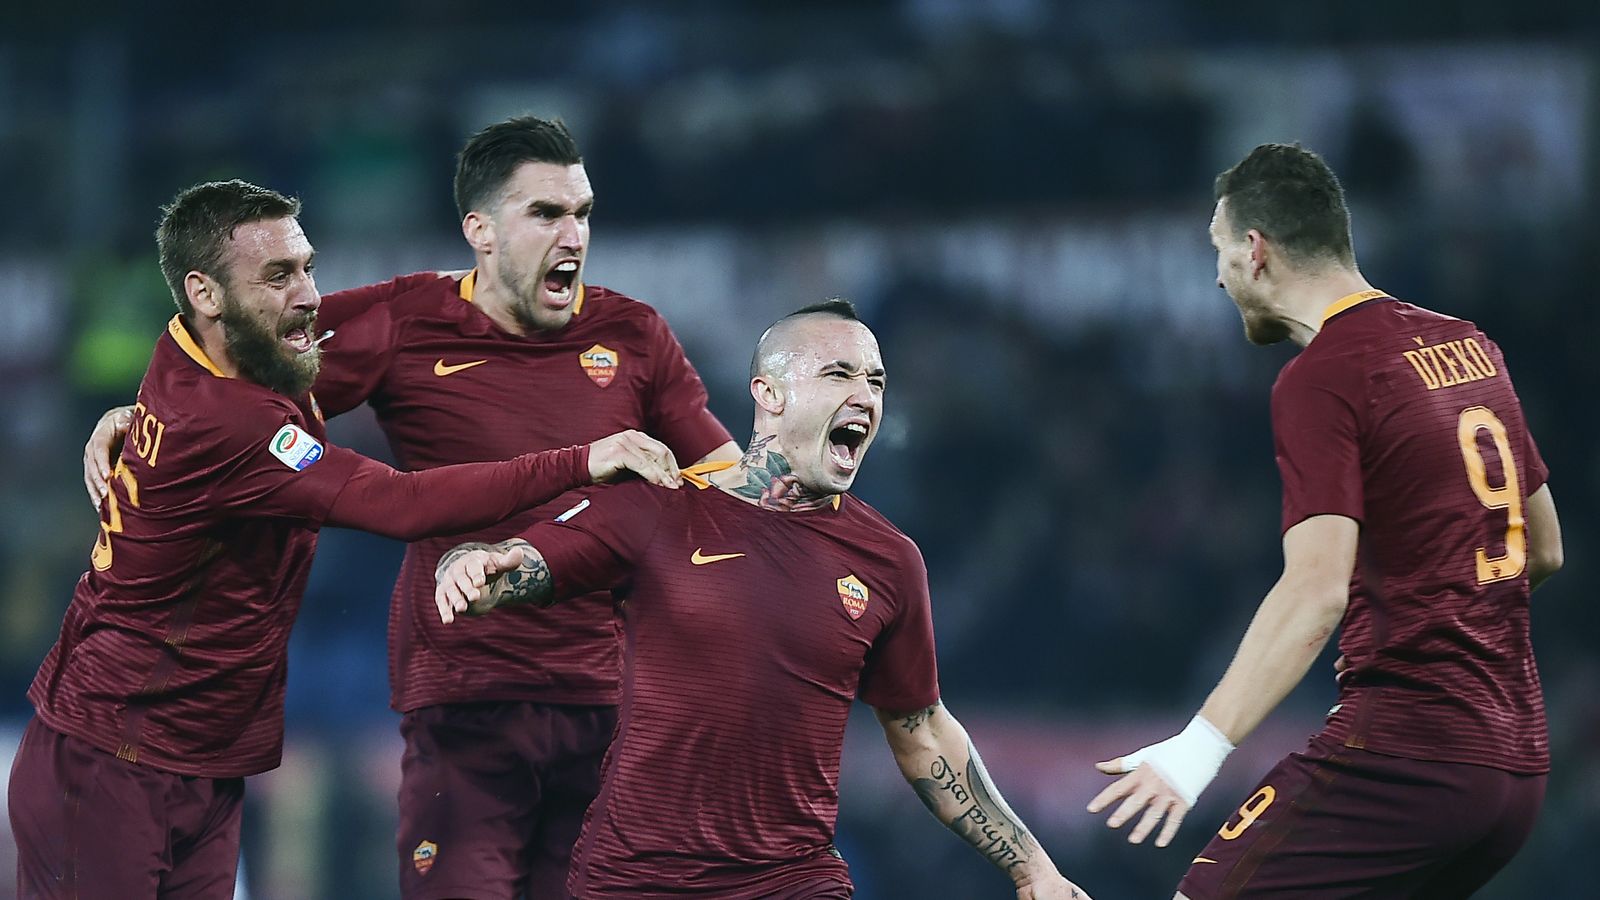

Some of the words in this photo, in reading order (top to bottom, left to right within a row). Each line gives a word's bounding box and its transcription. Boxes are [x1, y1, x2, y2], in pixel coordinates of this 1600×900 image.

[1402, 336, 1497, 390] DŽEKO
[1457, 405, 1527, 586] 9
[842, 597, 866, 611] ROMA
[1217, 785, 1277, 840] 9
